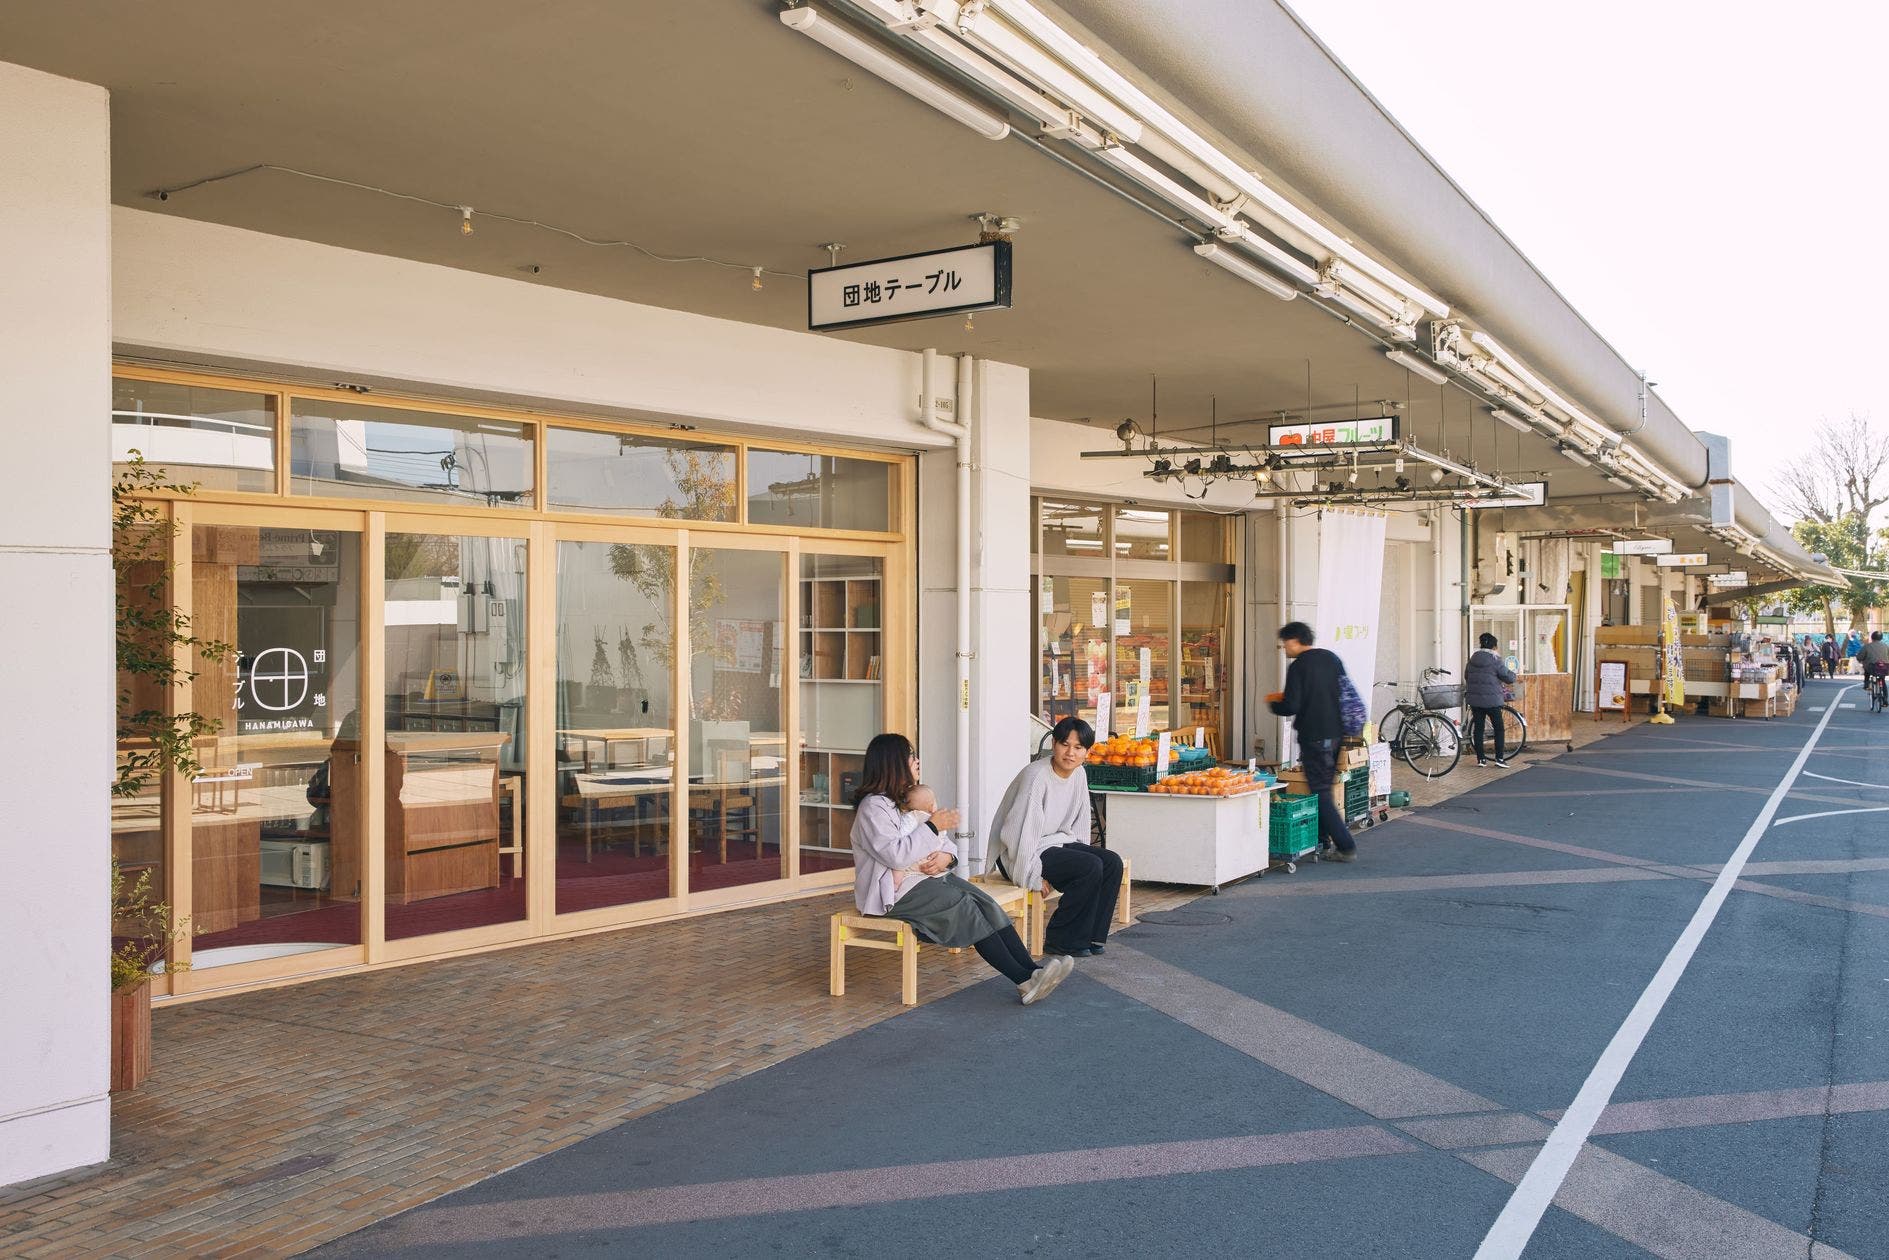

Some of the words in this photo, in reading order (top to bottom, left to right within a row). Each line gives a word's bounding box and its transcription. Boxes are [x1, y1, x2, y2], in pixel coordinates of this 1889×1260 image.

[843, 269, 962, 307] 団地テーブル
[232, 650, 246, 710] テーブル
[313, 649, 326, 707] 団地
[245, 719, 314, 730] HANAMIGAWA
[228, 767, 253, 777] OPEN
